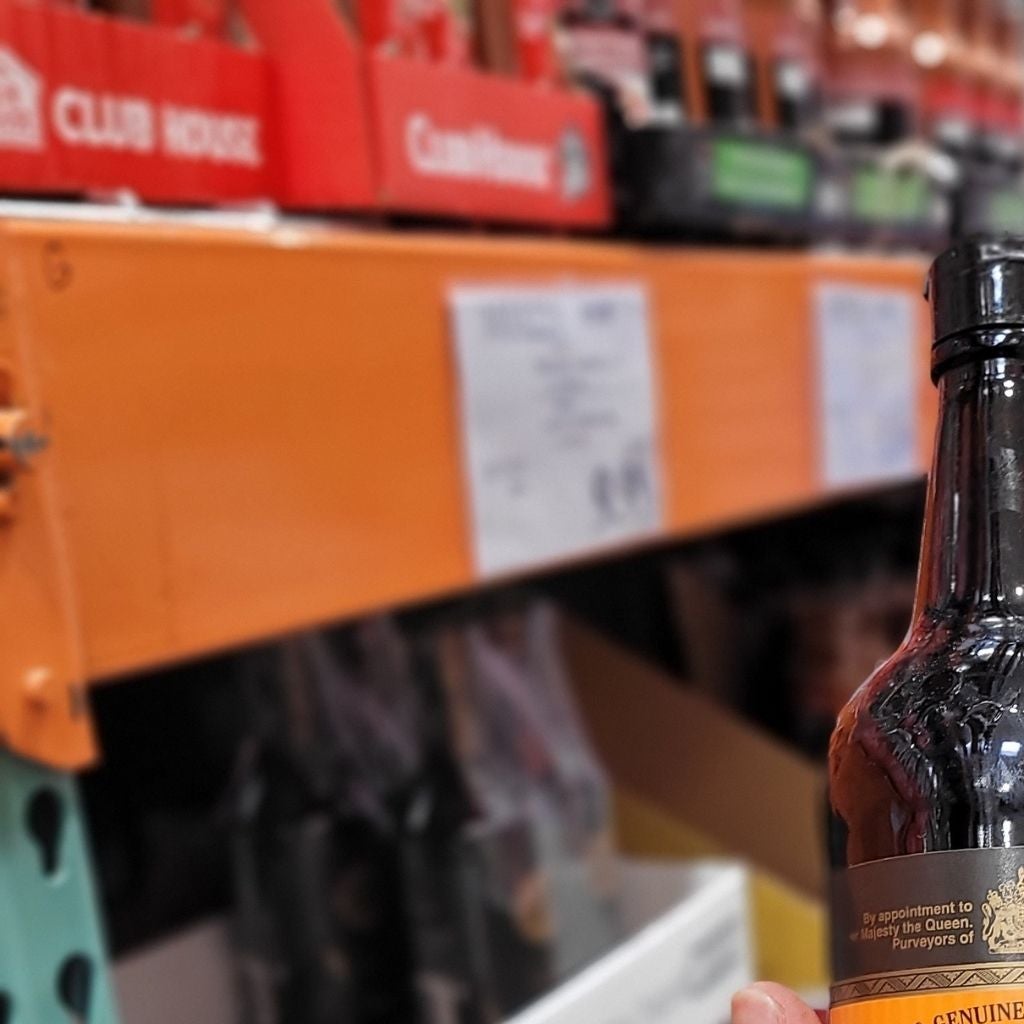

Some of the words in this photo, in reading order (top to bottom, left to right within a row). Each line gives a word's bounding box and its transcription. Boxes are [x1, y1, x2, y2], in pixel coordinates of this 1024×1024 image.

[53, 87, 153, 153] CLUB
[162, 103, 262, 167] HOUSE
[863, 912, 876, 926] By
[878, 901, 955, 924] appointment
[959, 901, 974, 913] to
[861, 924, 900, 941] Majesty
[902, 921, 921, 934] the
[925, 918, 974, 932] Queen.
[892, 934, 956, 950] Purveyors
[960, 930, 974, 944] of
